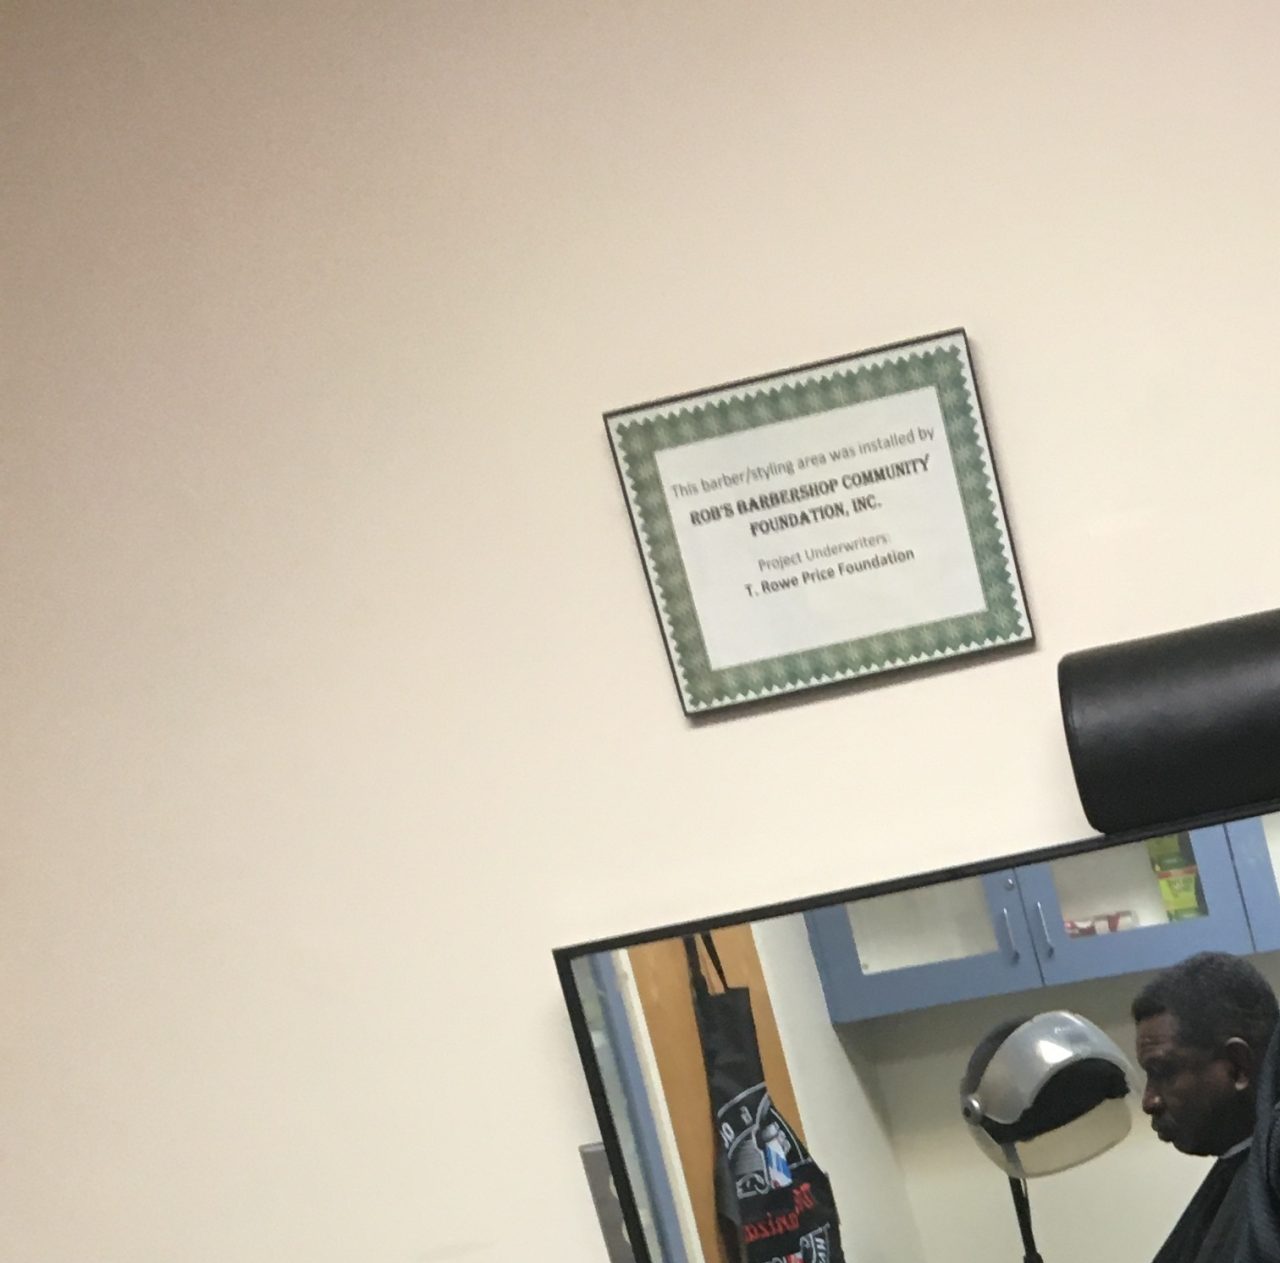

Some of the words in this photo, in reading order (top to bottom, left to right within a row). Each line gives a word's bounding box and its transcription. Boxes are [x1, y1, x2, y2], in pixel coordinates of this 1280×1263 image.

[671, 483, 699, 498] This
[700, 459, 795, 493] barber/styling
[797, 453, 827, 470] area
[829, 446, 856, 462] was
[858, 428, 915, 455] installed
[917, 426, 935, 441] by
[689, 502, 735, 526] ROB'S
[736, 478, 838, 515] BARBERSHOP
[841, 452, 930, 490] COMMUNITY
[749, 502, 850, 537] FOUNDATION,
[851, 493, 883, 514] INC.
[744, 583, 759, 598] T.
[761, 574, 800, 595] Rowe
[801, 565, 836, 585] Price
[837, 548, 916, 577] Foundation
[757, 552, 802, 572] Project
[803, 533, 892, 563] Underwriters:
